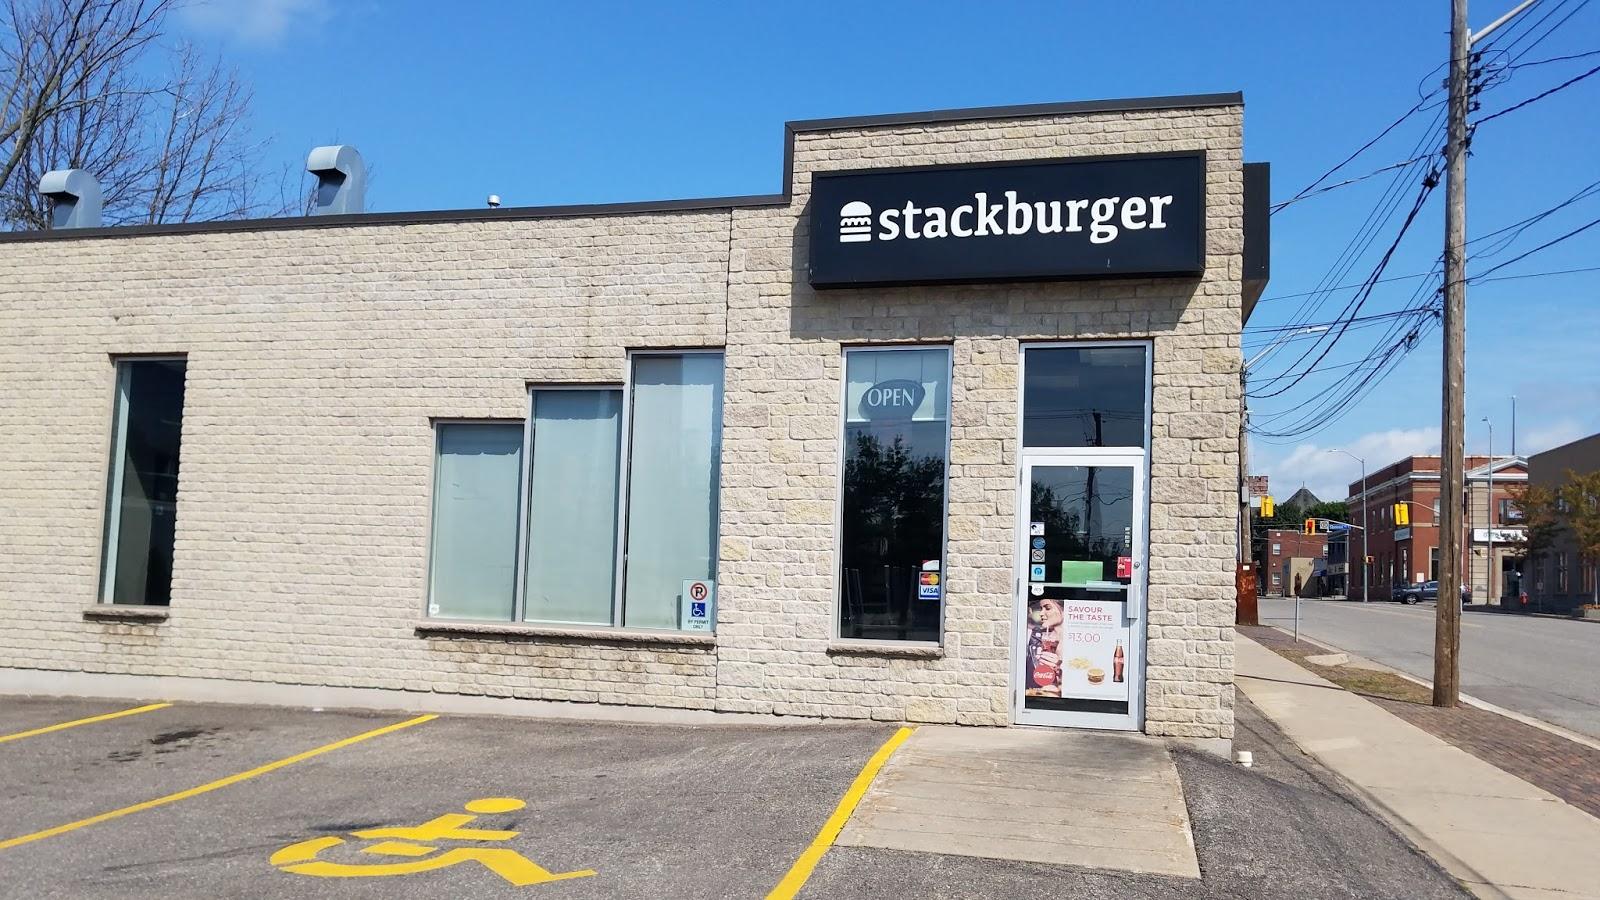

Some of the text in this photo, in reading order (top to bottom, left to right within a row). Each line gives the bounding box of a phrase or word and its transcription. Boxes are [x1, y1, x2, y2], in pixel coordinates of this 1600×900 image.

[878, 190, 1173, 244] stackburger
[867, 388, 915, 407] OPEN
[1068, 605, 1103, 613] SAVOUR
[1068, 613, 1113, 622] THE TASTE
